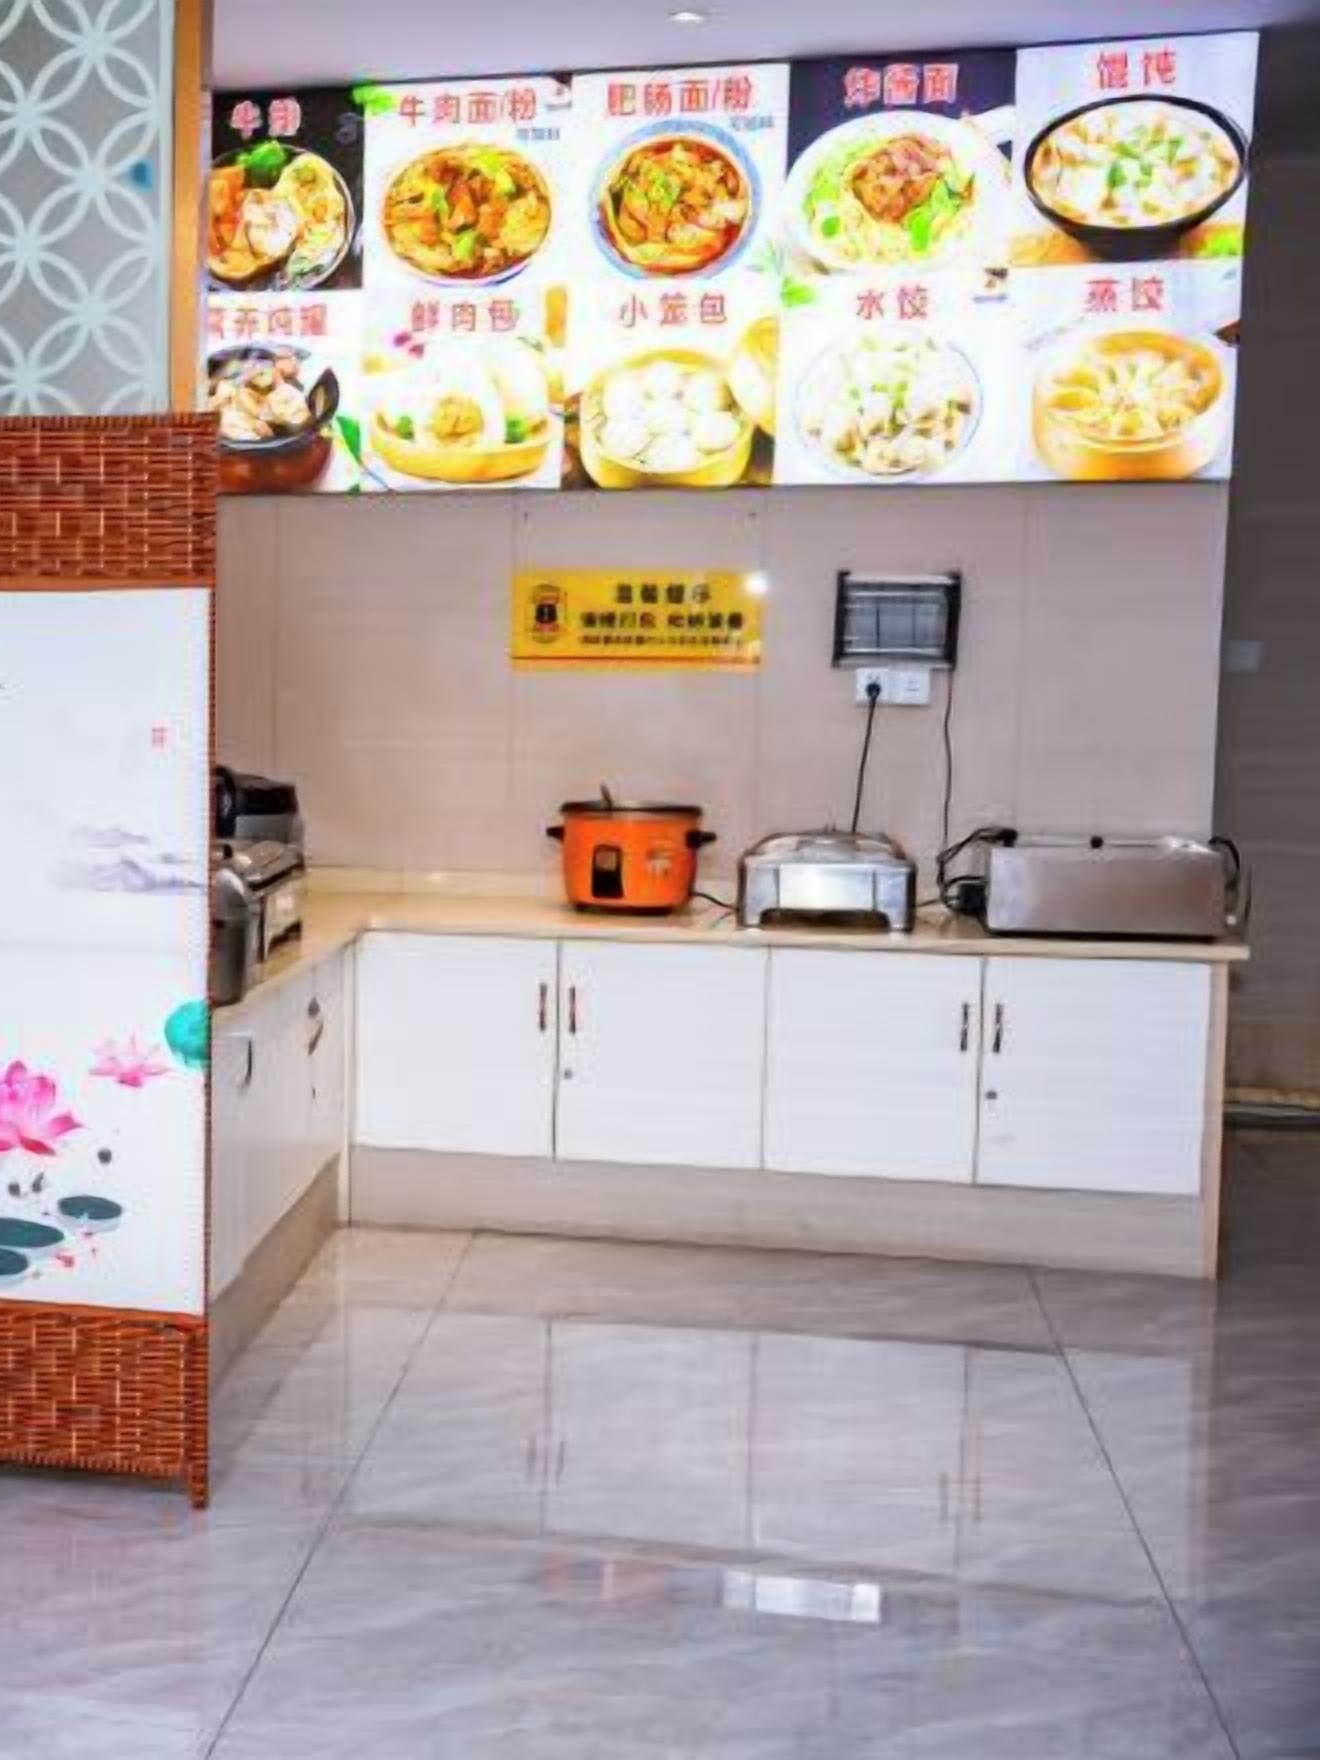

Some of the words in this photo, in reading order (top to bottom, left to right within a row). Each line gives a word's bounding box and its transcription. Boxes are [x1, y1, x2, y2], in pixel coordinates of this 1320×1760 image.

[620, 292, 727, 327] 小笼包
[856, 285, 928, 321] 水饺
[1086, 276, 1165, 313] 蒸饺
[411, 299, 520, 333] 鲜肉包
